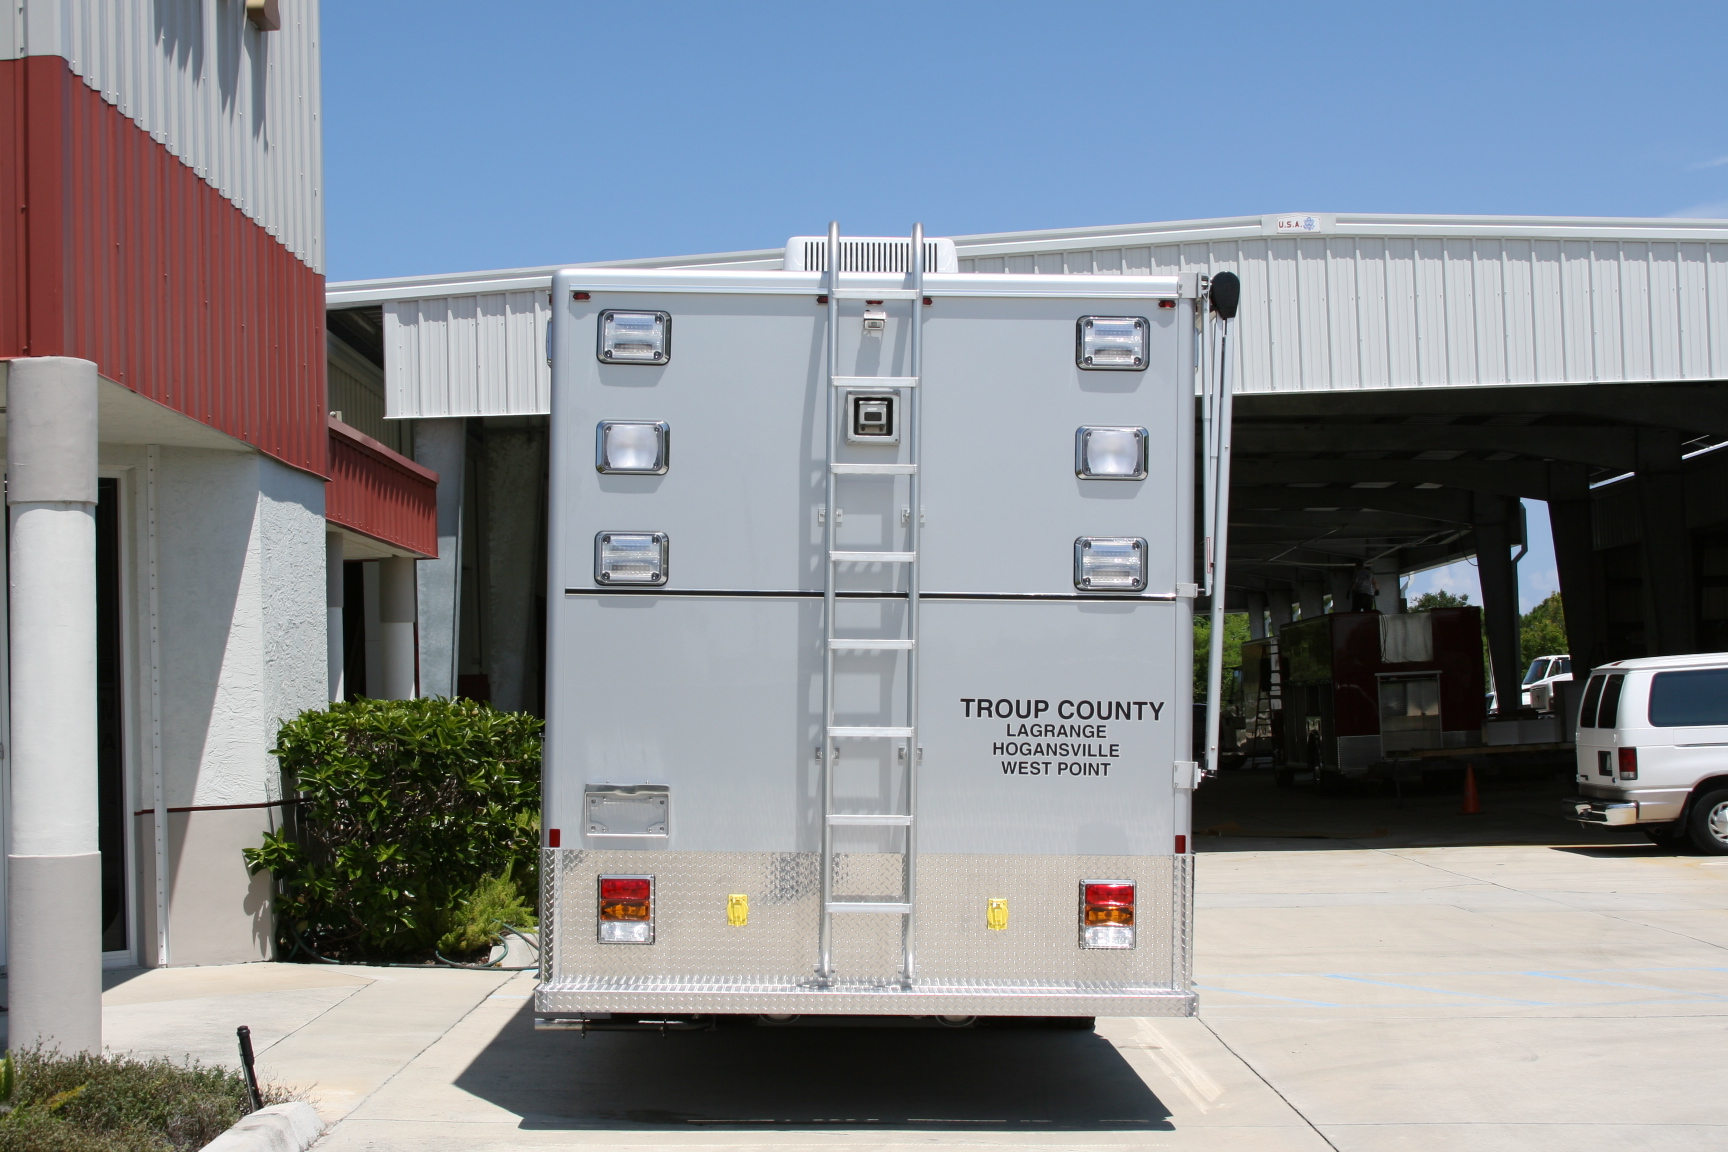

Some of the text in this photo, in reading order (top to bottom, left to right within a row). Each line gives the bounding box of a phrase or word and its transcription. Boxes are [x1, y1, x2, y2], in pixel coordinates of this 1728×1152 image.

[1278, 220, 1303, 228] U.S.A.
[960, 698, 1165, 721] TROUP COUNTY
[1006, 723, 1107, 738] LAGRANGE
[992, 741, 1120, 757] HOGANSVILLE
[1001, 760, 1112, 776] WEST POINT
